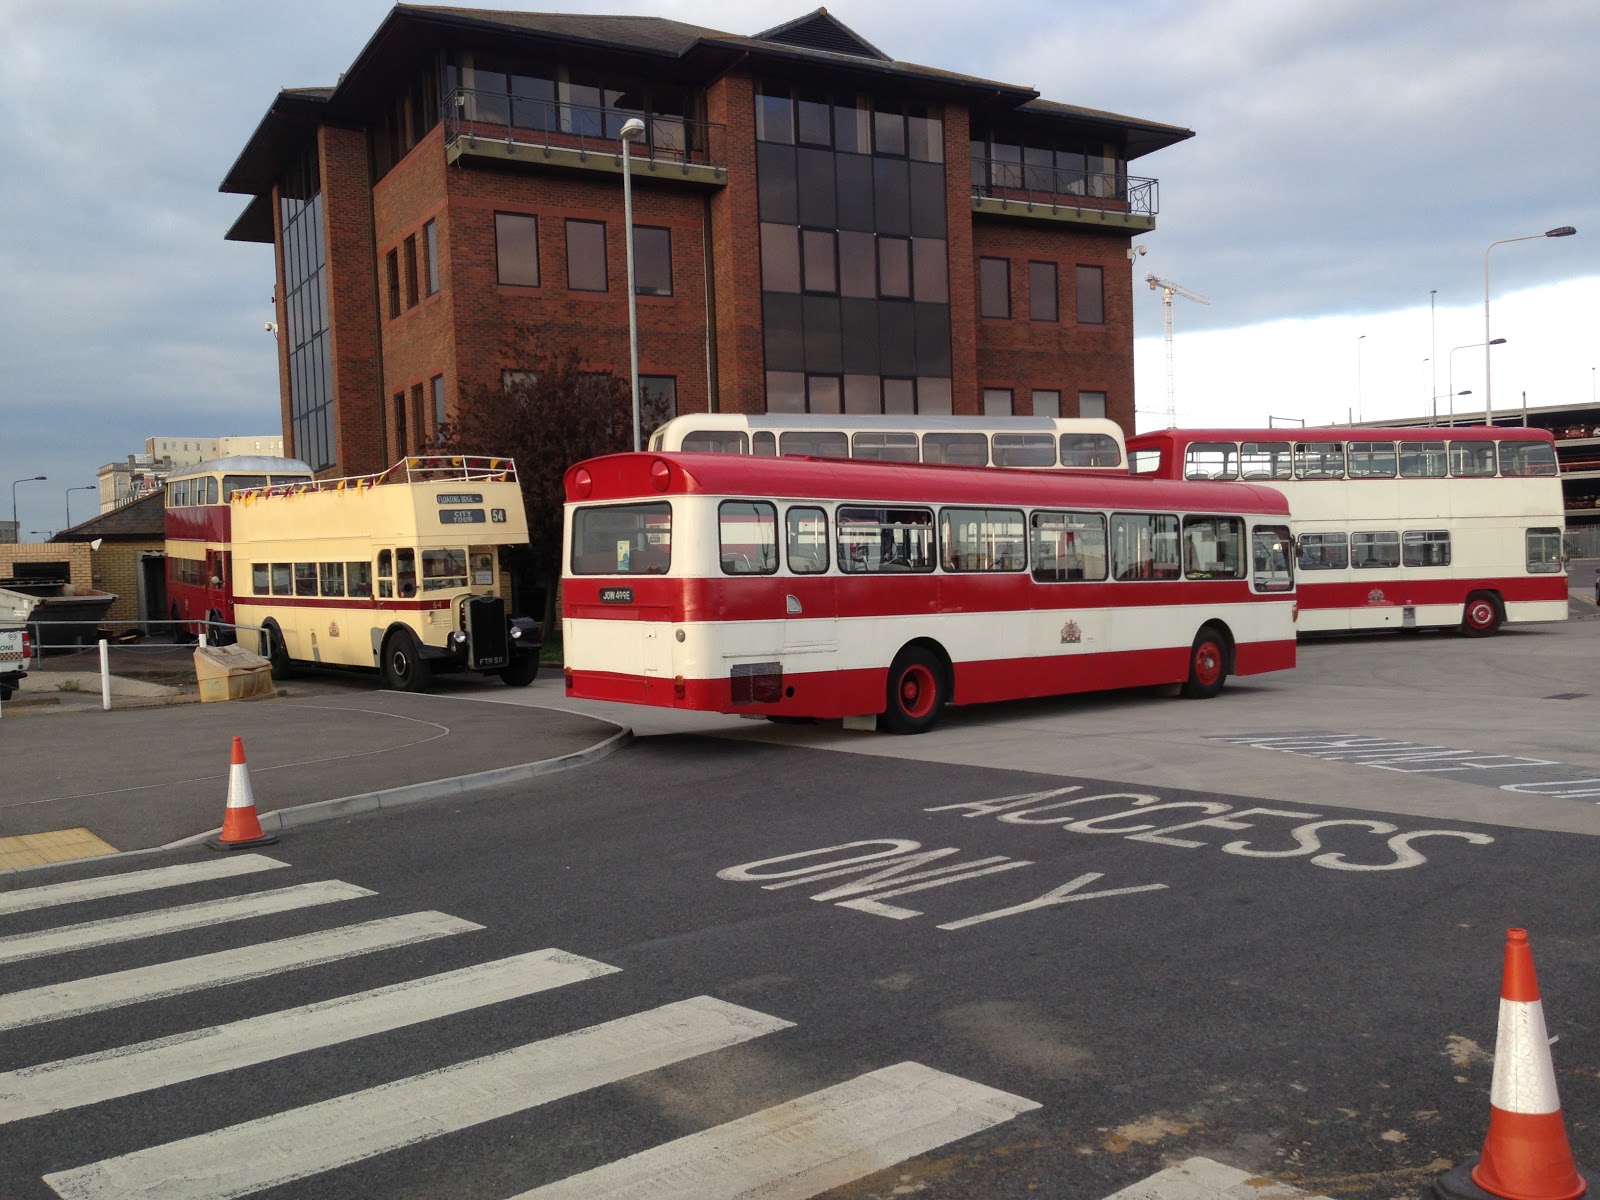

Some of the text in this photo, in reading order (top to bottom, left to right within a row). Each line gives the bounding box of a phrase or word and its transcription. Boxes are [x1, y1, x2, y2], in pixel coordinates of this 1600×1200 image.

[438, 495, 460, 504] FLOATING
[492, 510, 504, 521] 54
[615, 591, 631, 600] 499E
[479, 657, 493, 665] FTR
[924, 785, 1495, 872] ACCESS
[716, 838, 1170, 930] ONLY
